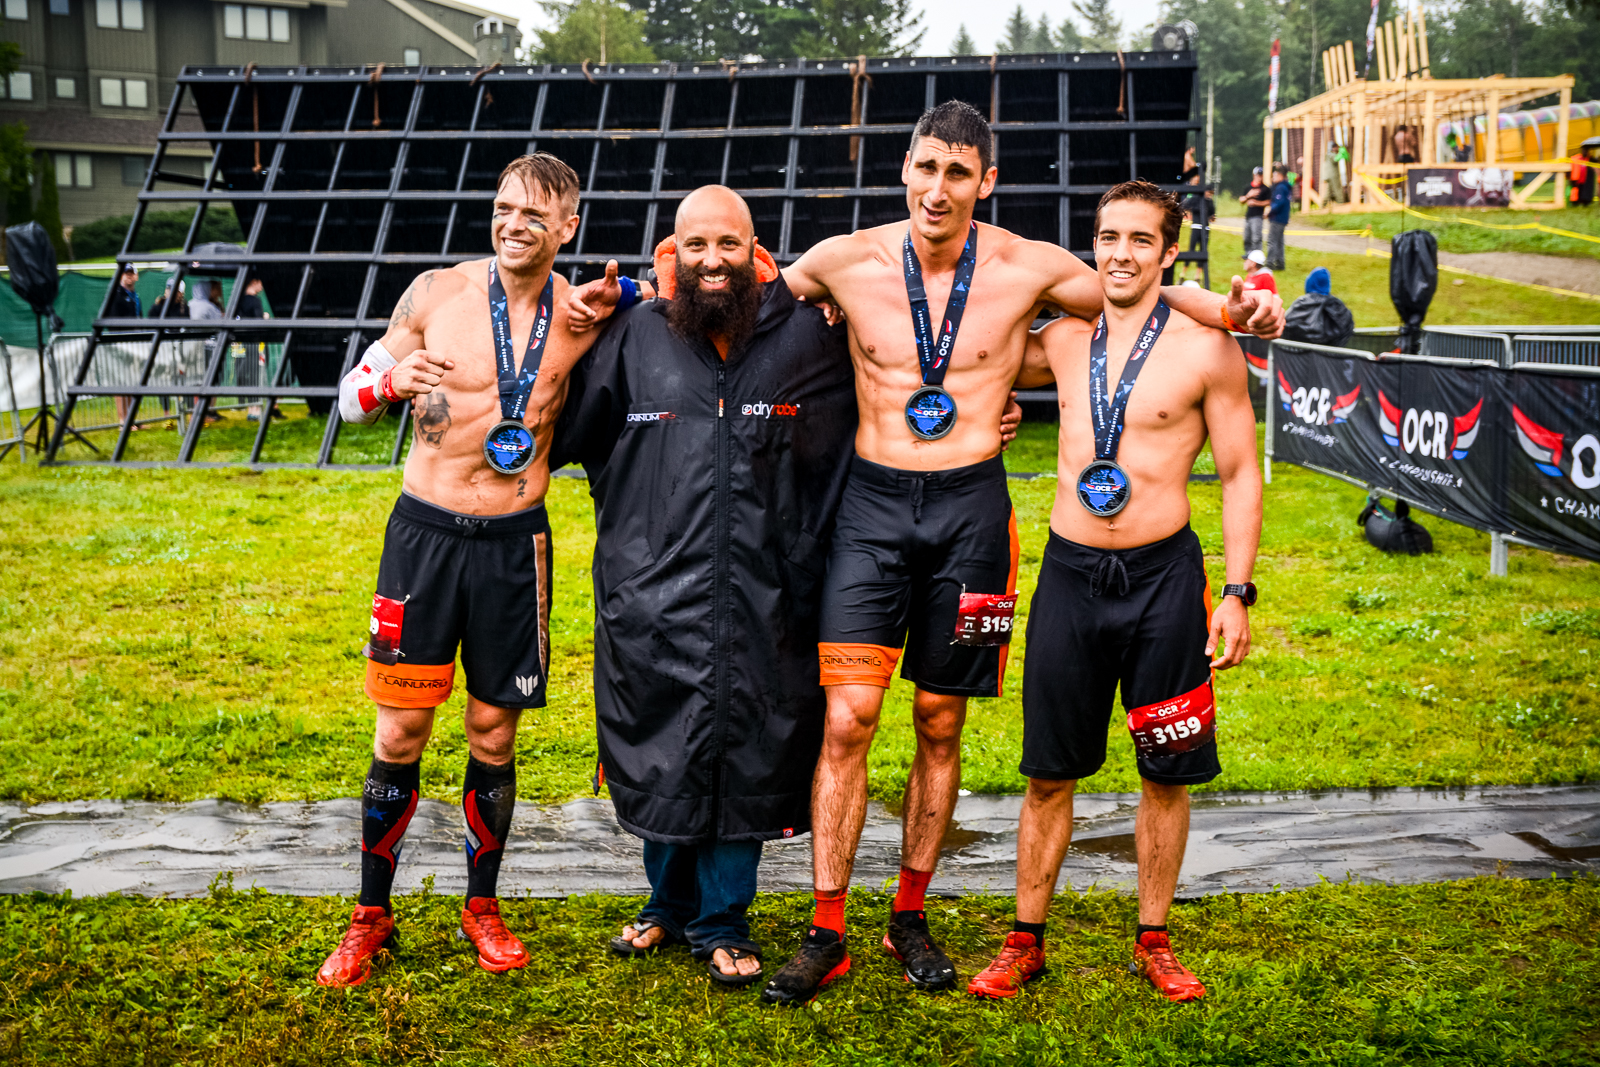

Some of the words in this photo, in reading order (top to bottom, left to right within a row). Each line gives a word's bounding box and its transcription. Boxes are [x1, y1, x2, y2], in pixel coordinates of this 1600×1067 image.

[535, 318, 547, 339] OCR
[939, 335, 951, 356] OCR
[1139, 330, 1155, 349] OCR
[753, 401, 798, 419] dryrobe
[1402, 407, 1448, 460] OCR
[1555, 497, 1600, 519] CHAM
[997, 601, 1014, 609] OCR
[1157, 704, 1179, 717] OCR
[1152, 716, 1201, 745] 3159
